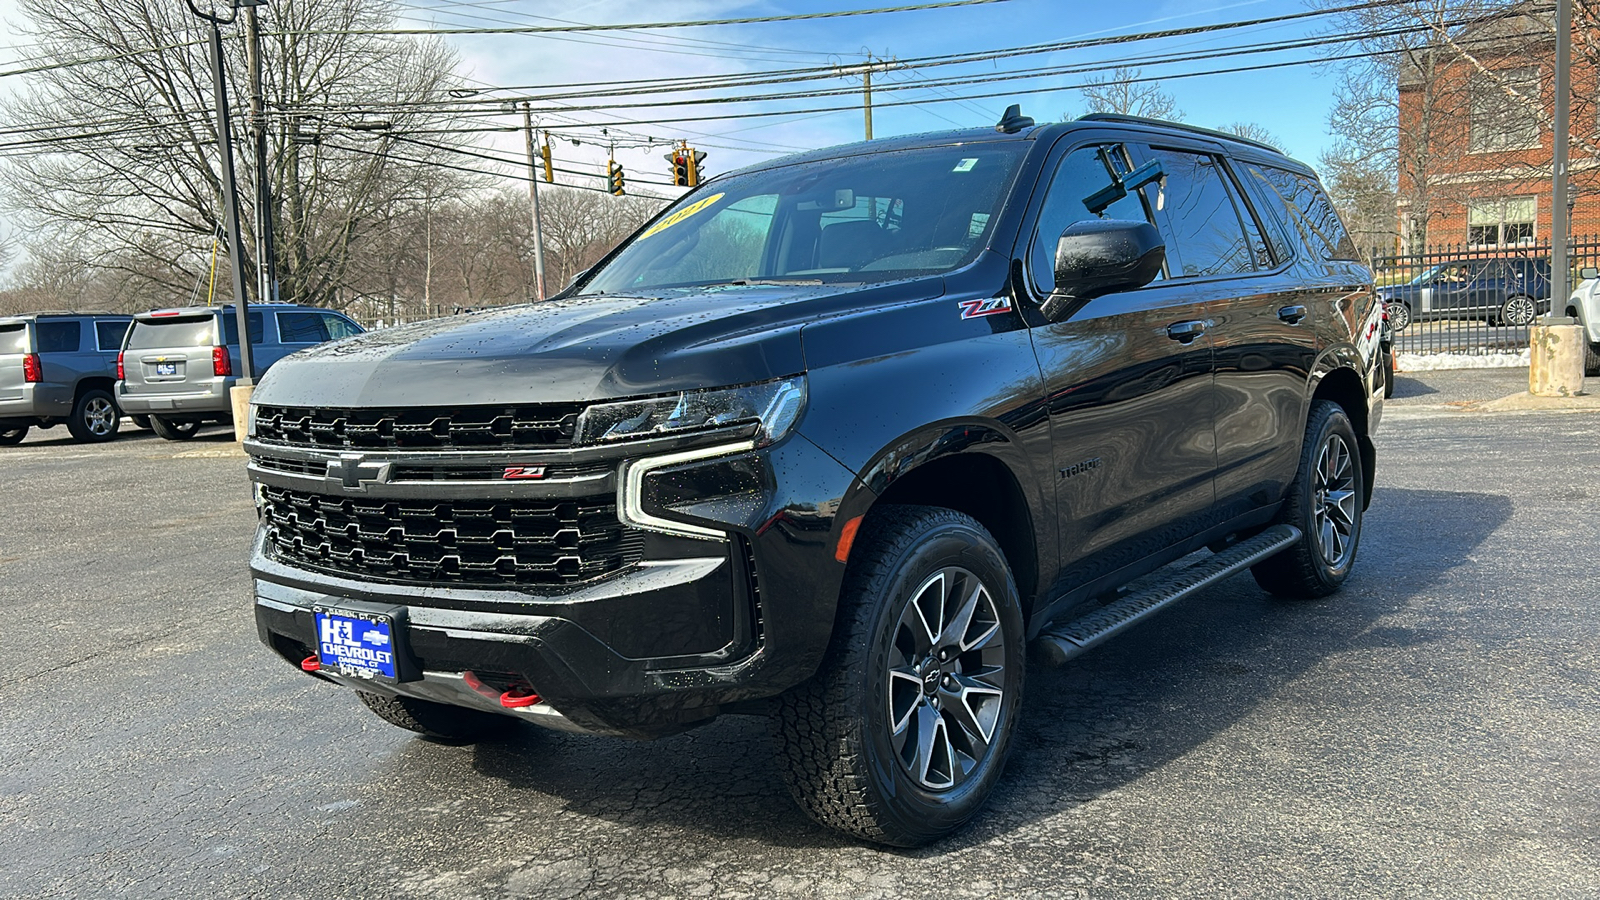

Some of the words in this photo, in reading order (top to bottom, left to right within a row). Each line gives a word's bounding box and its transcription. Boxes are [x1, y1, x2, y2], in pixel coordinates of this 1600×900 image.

[649, 198, 710, 234] 2021
[957, 296, 1012, 320] Z71
[503, 466, 547, 478] Z71
[1059, 457, 1102, 479] TAHOE
[321, 618, 362, 647] H&L
[322, 642, 392, 664] CHEVROLET
